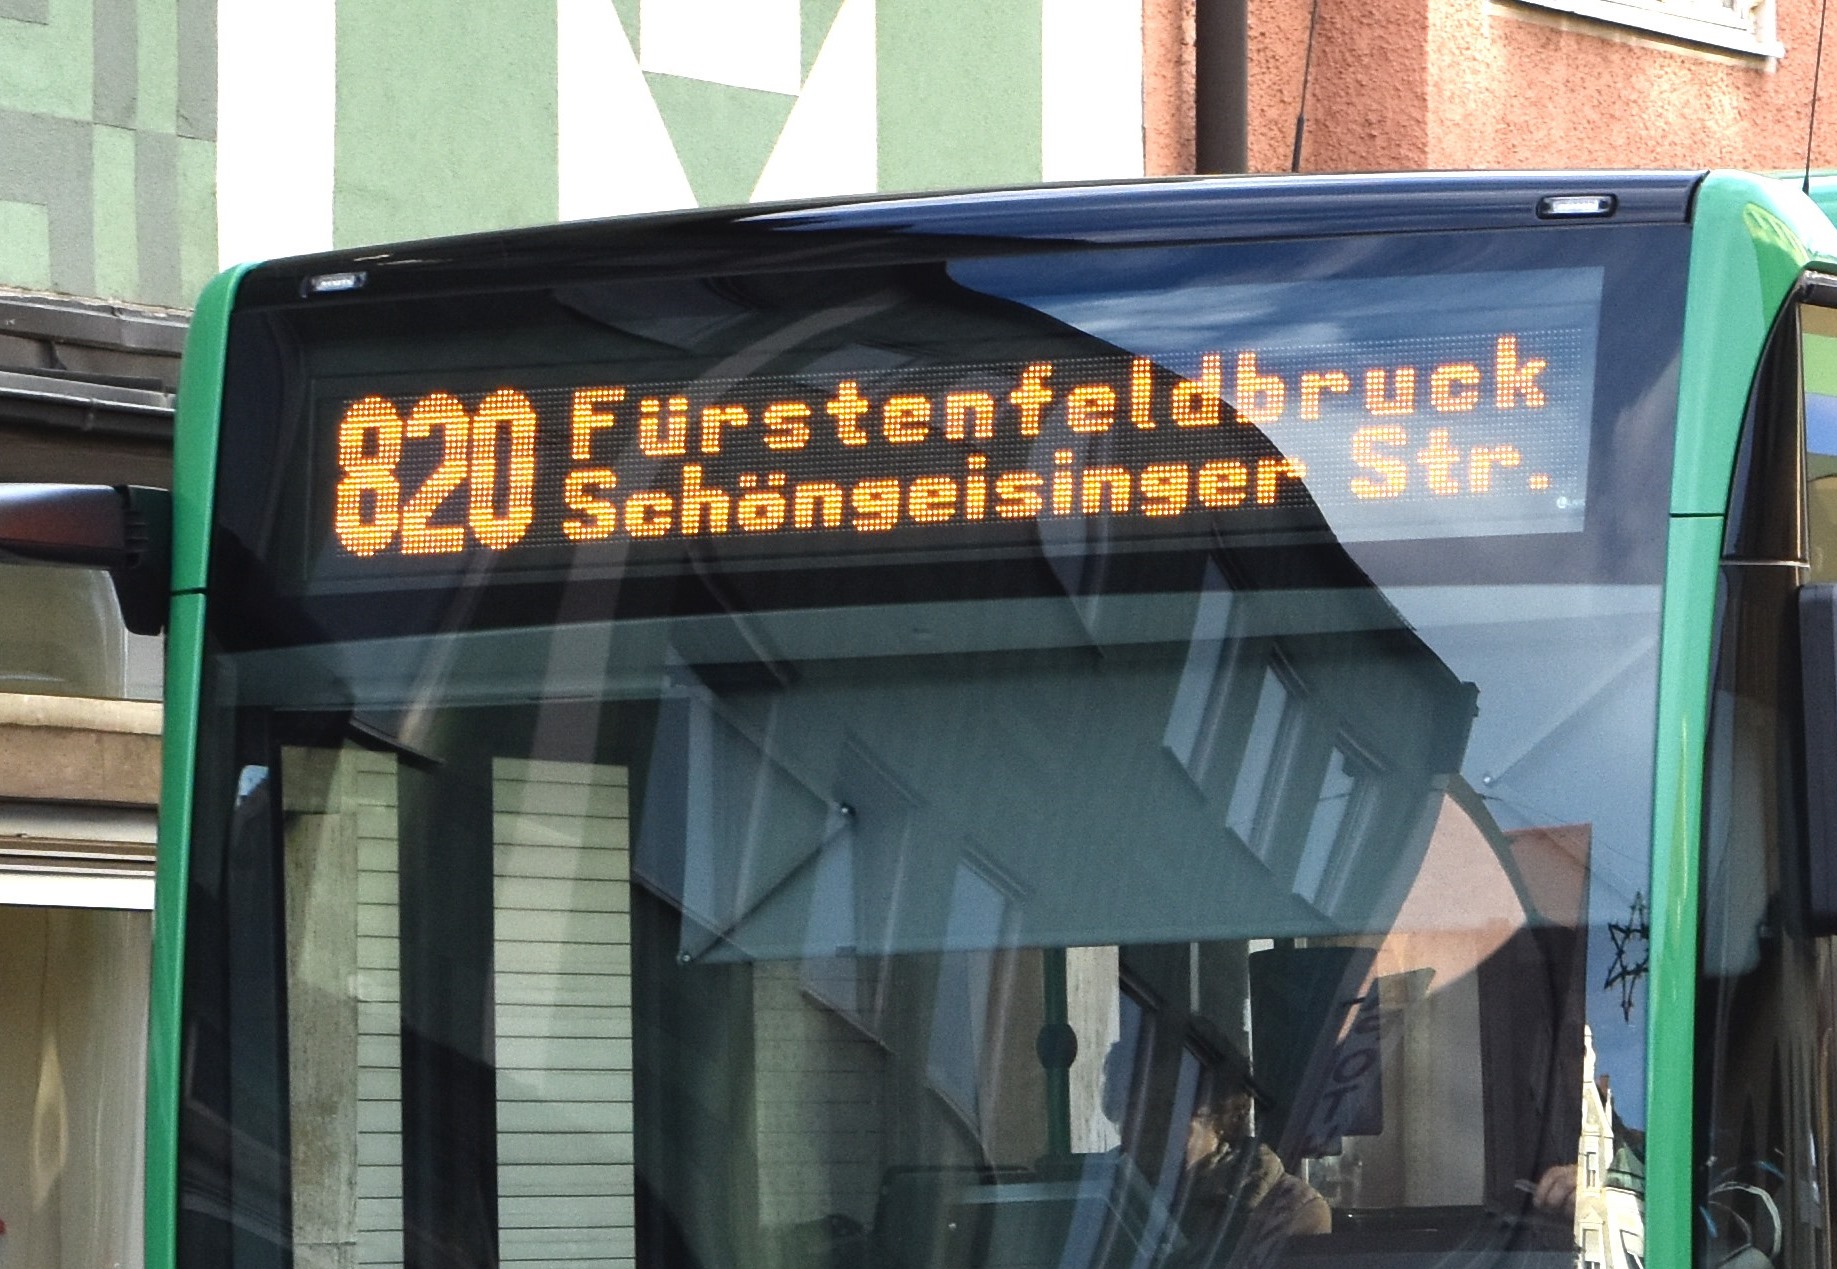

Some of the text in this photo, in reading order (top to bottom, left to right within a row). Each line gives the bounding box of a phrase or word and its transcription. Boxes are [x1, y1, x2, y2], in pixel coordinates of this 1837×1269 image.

[568, 335, 1548, 461] Fürstenfeldbruck
[335, 388, 538, 557] 820
[562, 425, 1552, 542] Schöngeisinger Str.
